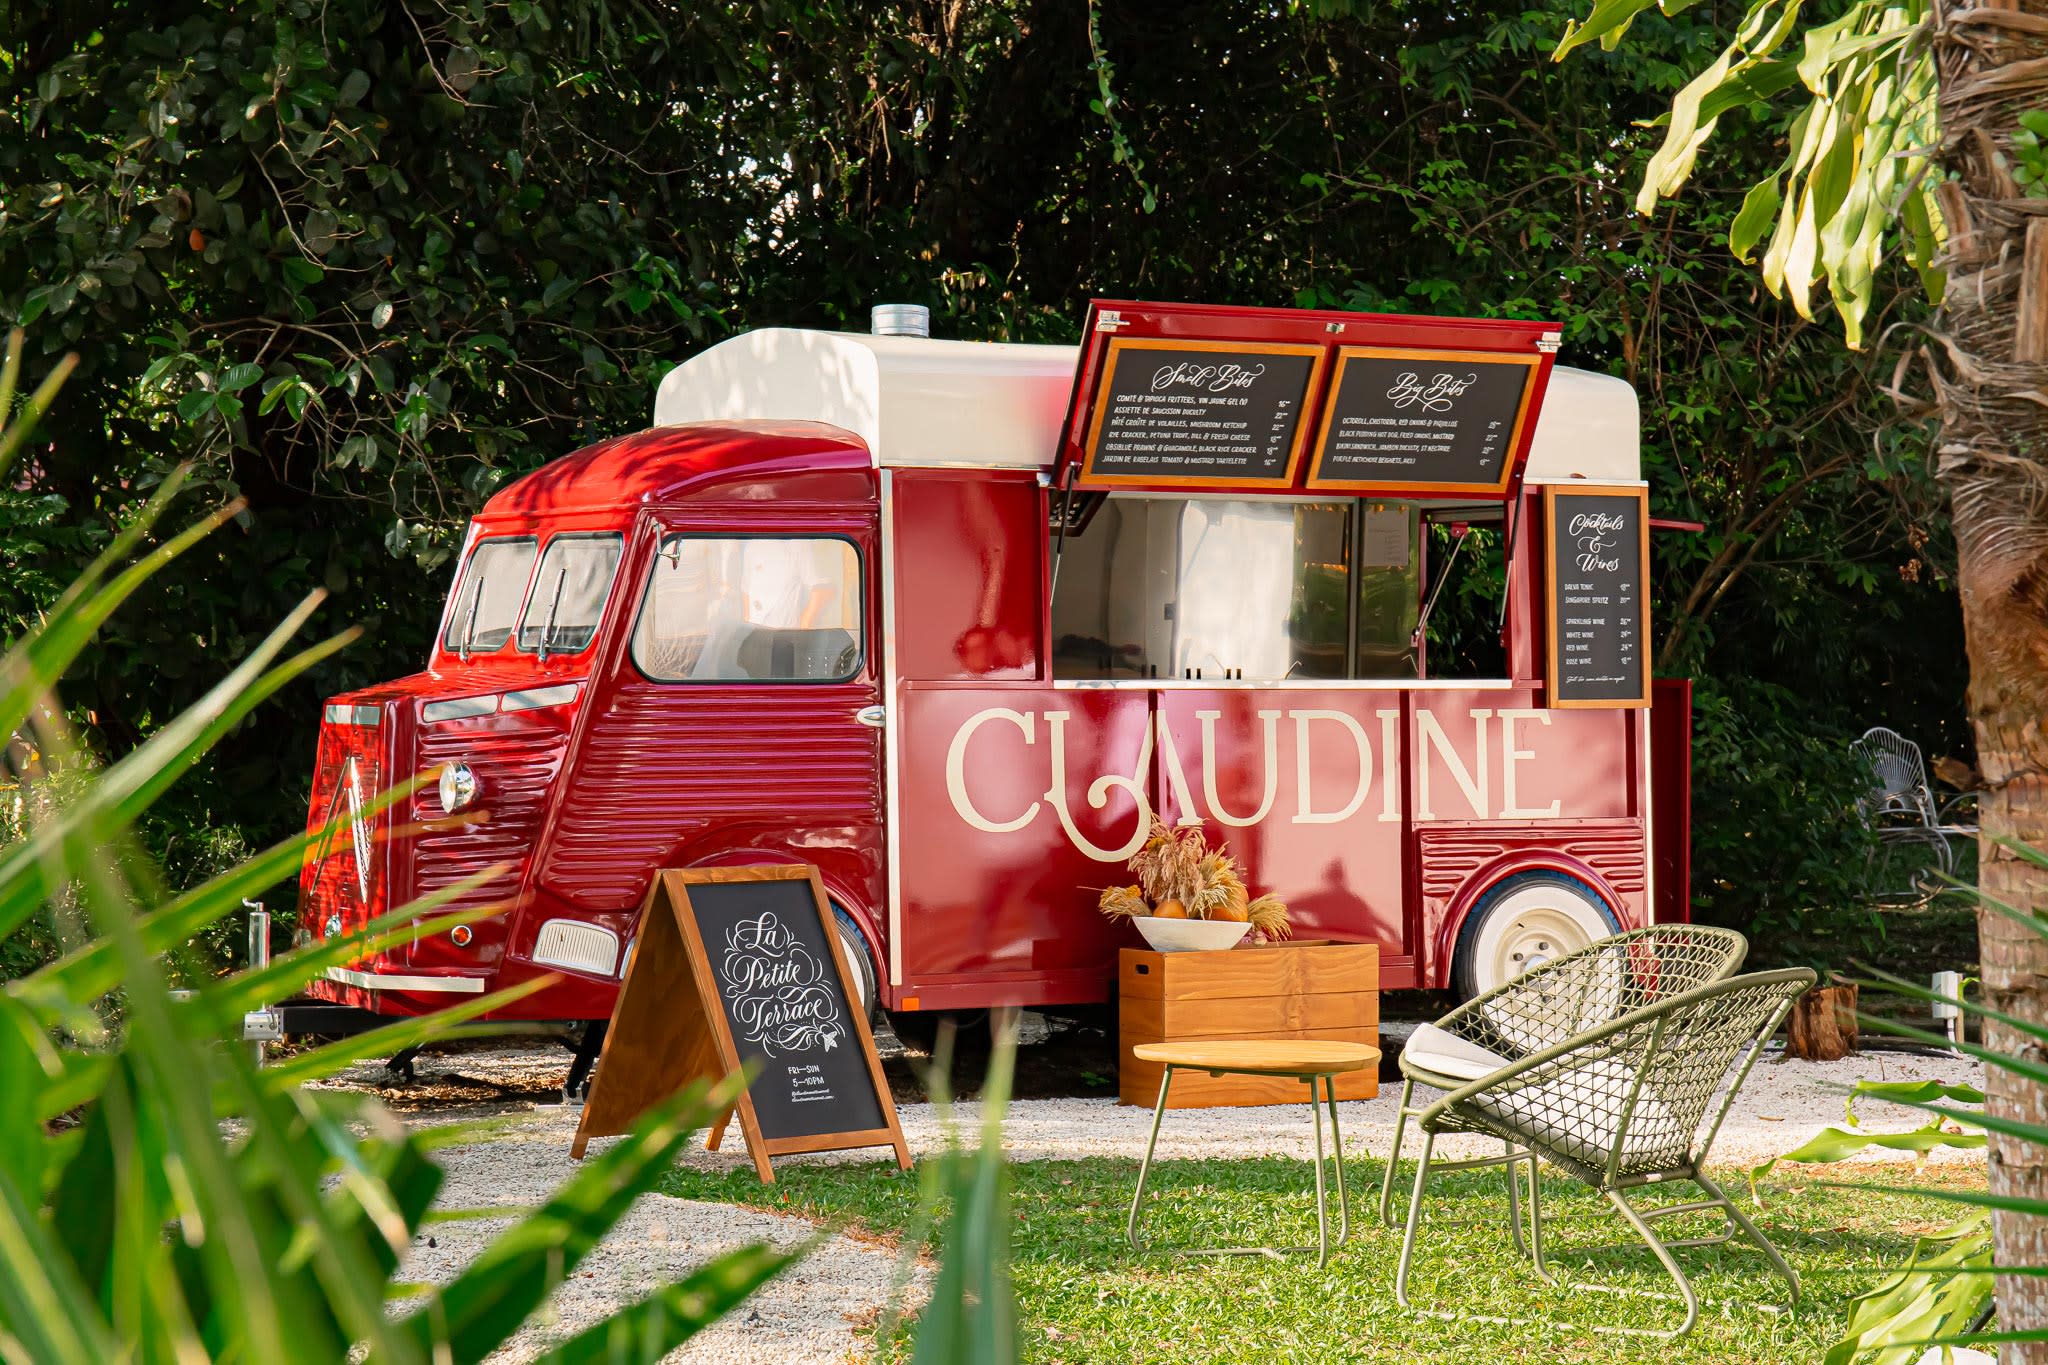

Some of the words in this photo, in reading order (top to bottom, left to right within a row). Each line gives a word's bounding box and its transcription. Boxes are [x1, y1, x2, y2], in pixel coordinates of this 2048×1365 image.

[1151, 363, 1216, 392] Small
[1209, 364, 1265, 392] Bites
[1423, 373, 1477, 400] Bites
[1114, 406, 1142, 414] ASSIETTE
[1152, 407, 1181, 415] SAUCISSON
[1168, 396, 1196, 404] FRITTERS,
[1569, 513, 1624, 536] Cocktails
[1578, 536, 1616, 553] &
[1576, 554, 1619, 572] Wines
[946, 708, 1561, 862] CLAUDINE
[734, 912, 786, 957] La
[733, 948, 814, 994] Petite
[740, 986, 832, 1034] Terrace
